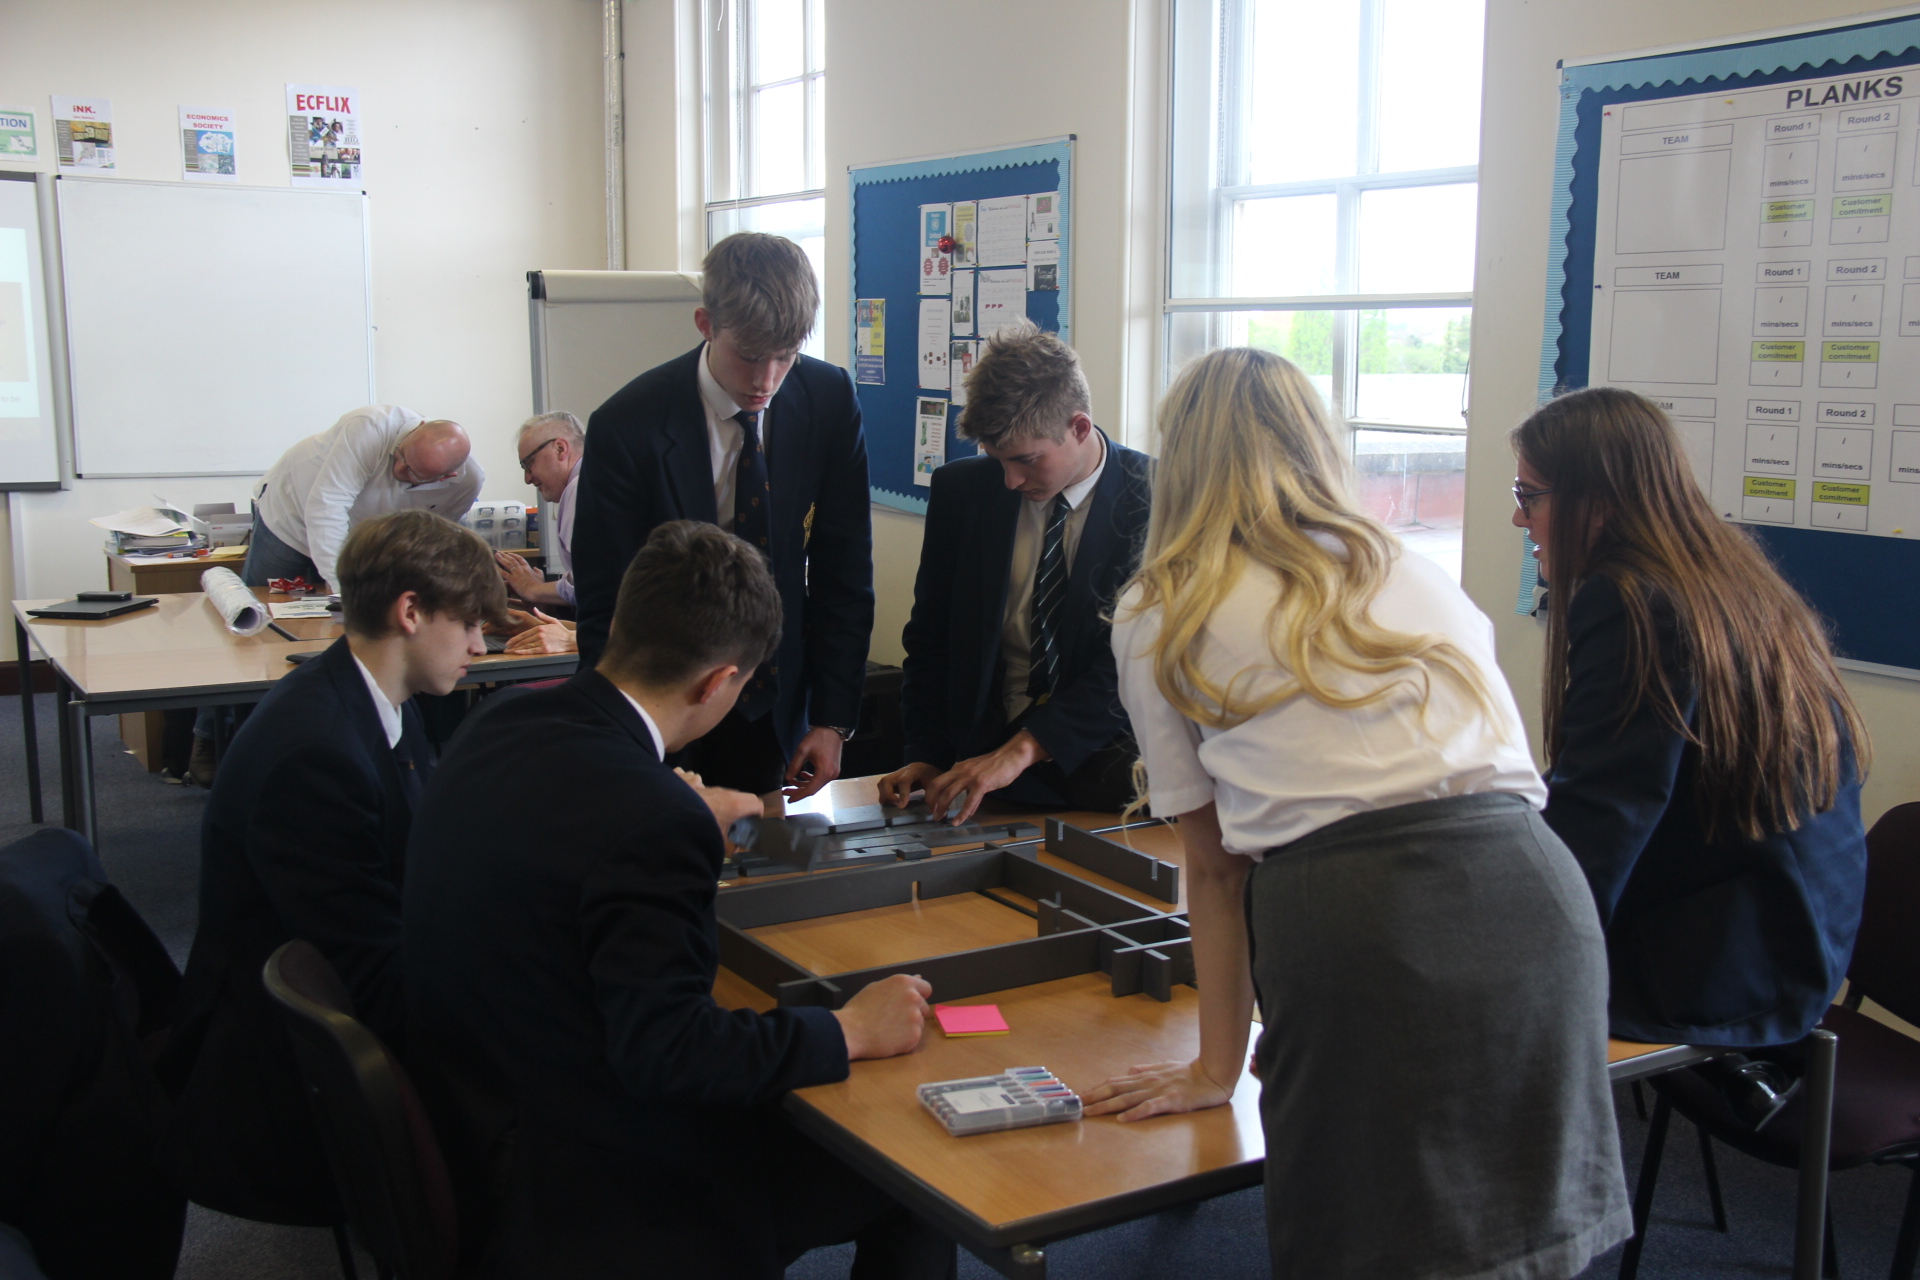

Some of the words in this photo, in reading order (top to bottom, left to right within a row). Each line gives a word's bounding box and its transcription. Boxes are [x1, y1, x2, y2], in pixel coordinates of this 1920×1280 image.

[1786, 76, 1903, 109] PLANKS
[296, 94, 351, 114] ECFLIX
[1847, 114, 1881, 125] Round
[1884, 113, 1891, 121] 2
[1774, 122, 1804, 133] Round
[1807, 122, 1812, 130] 1
[1662, 135, 1689, 145] TEAM
[1842, 172, 1886, 182] mins/secs
[1769, 179, 1809, 188] mins/secs
[1841, 198, 1882, 206] Customer
[1769, 203, 1806, 211] Customer
[1764, 268, 1794, 276] Round
[1836, 265, 1868, 274] Round
[1871, 265, 1877, 273] 2
[1655, 271, 1680, 280] TEAM
[1760, 320, 1799, 328] mins/secs
[1831, 320, 1873, 328] mins/secs
[1755, 406, 1785, 414] Round
[1826, 408, 1858, 417] Round
[1860, 410, 1867, 418] 2
[1751, 457, 1790, 466] mins/secs
[1821, 462, 1863, 470] mins/secs
[1752, 479, 1787, 488] Customer
[1821, 485, 1860, 493] Customer
